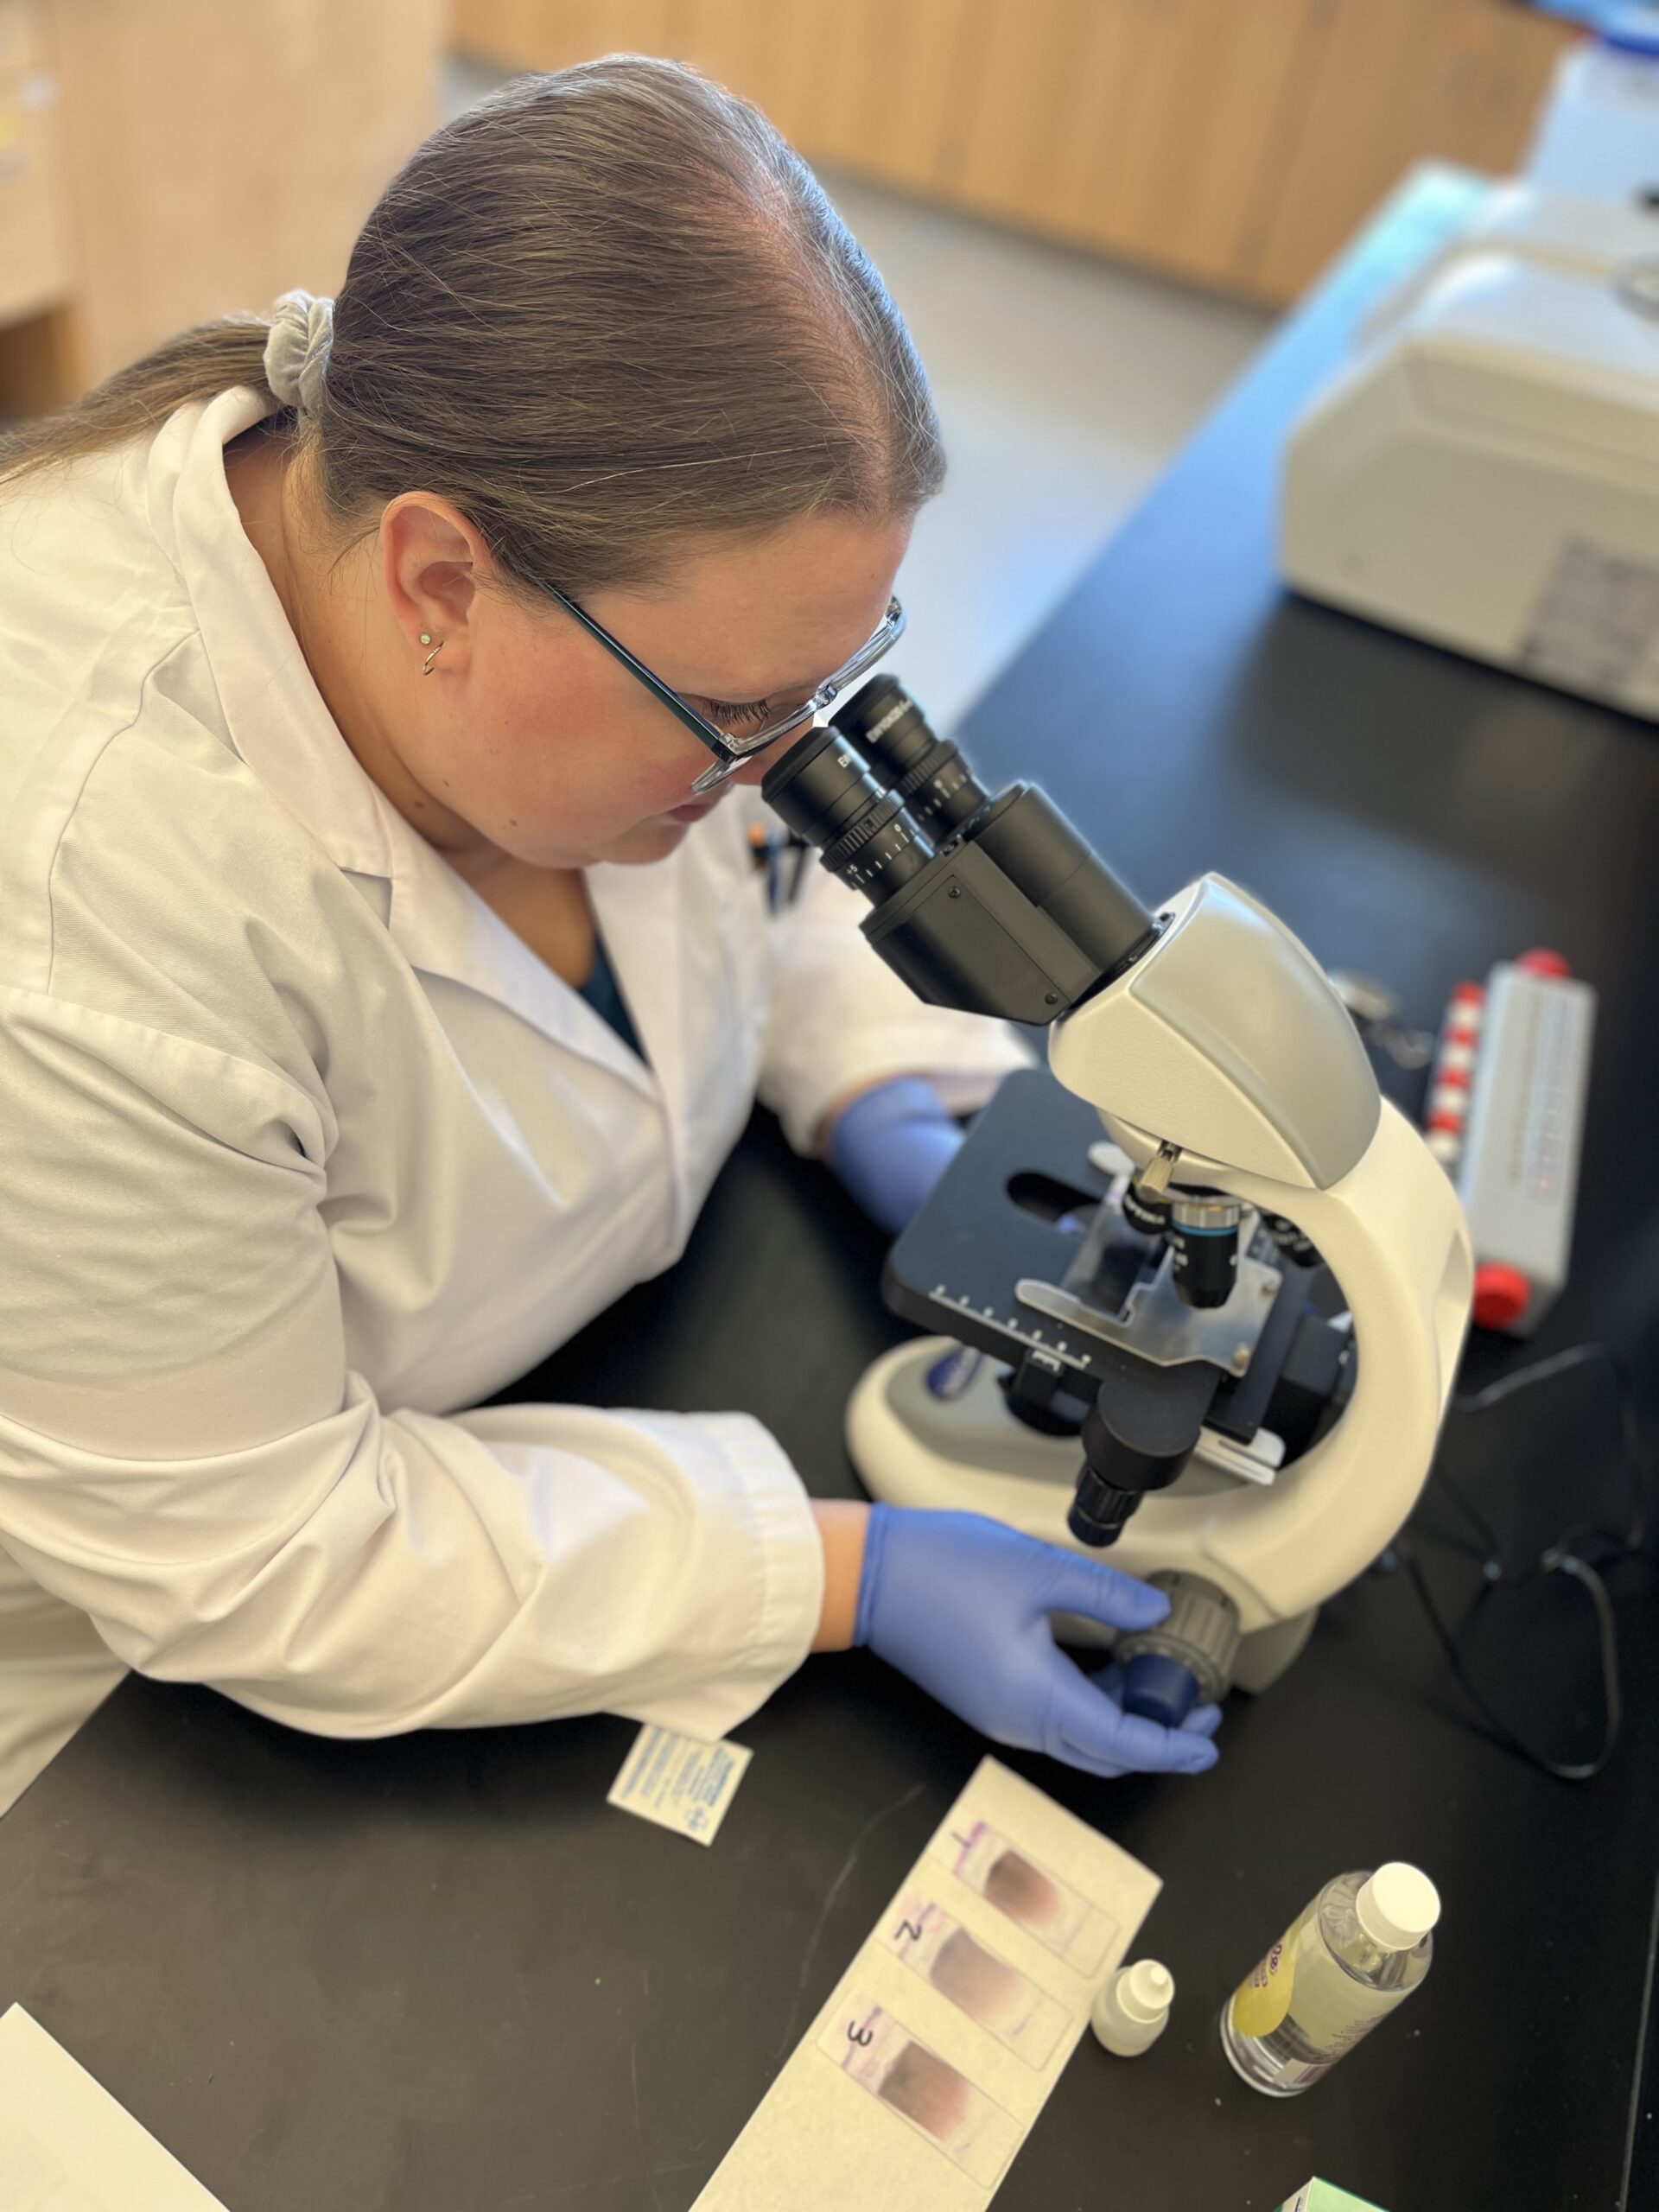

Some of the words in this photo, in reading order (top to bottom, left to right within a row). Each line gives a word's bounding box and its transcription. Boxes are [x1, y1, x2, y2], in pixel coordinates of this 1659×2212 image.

[847, 864, 858, 876] +5
[893, 1920, 923, 1942] 2
[847, 2020, 874, 2048] 3
